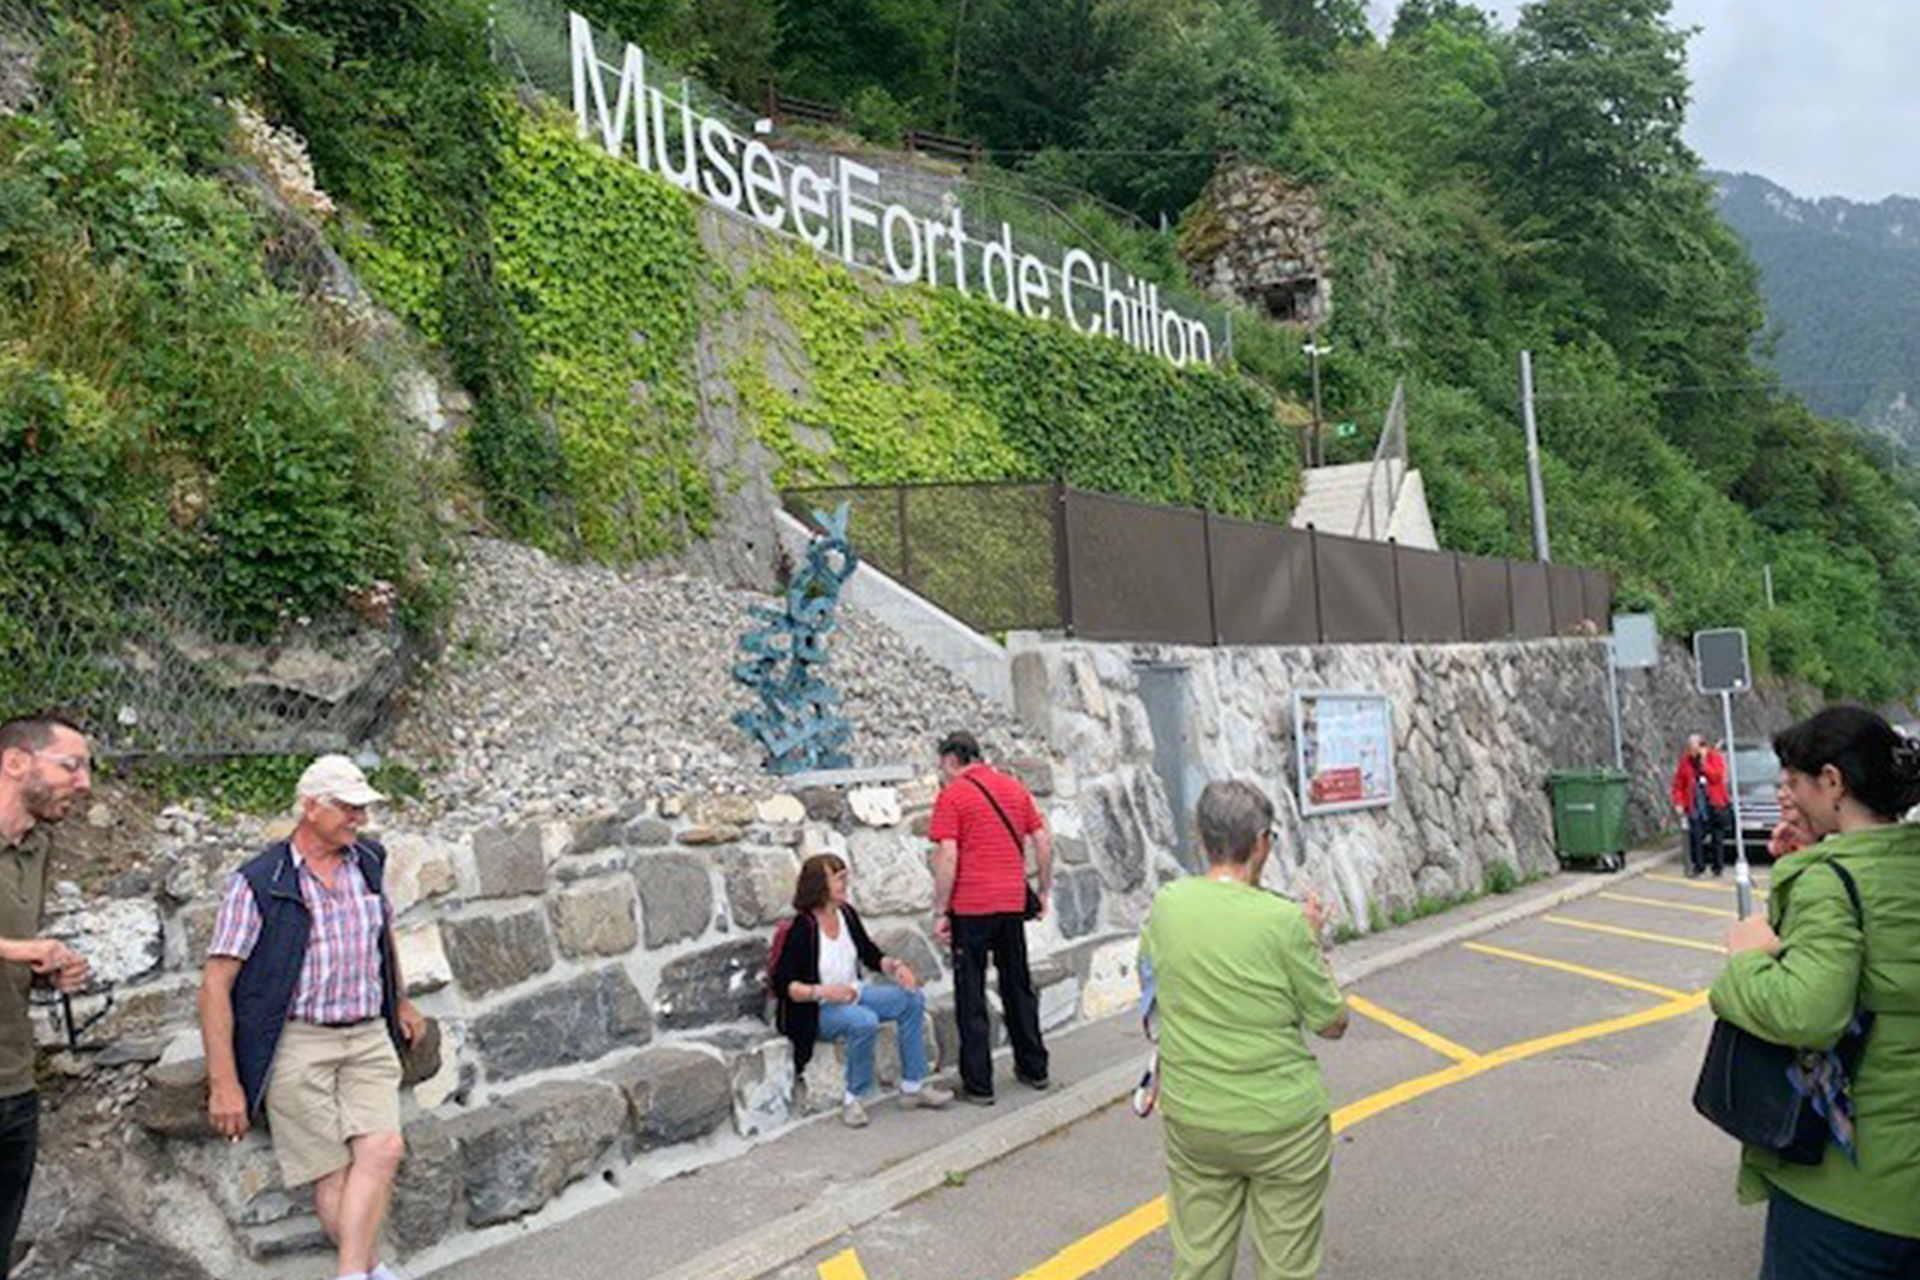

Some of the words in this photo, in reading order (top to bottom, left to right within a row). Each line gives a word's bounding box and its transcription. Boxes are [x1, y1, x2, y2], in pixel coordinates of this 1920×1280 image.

[570, 11, 829, 249] Musée
[839, 157, 971, 298] Fort
[983, 222, 1050, 321] de
[1062, 250, 1211, 368] Chillon
